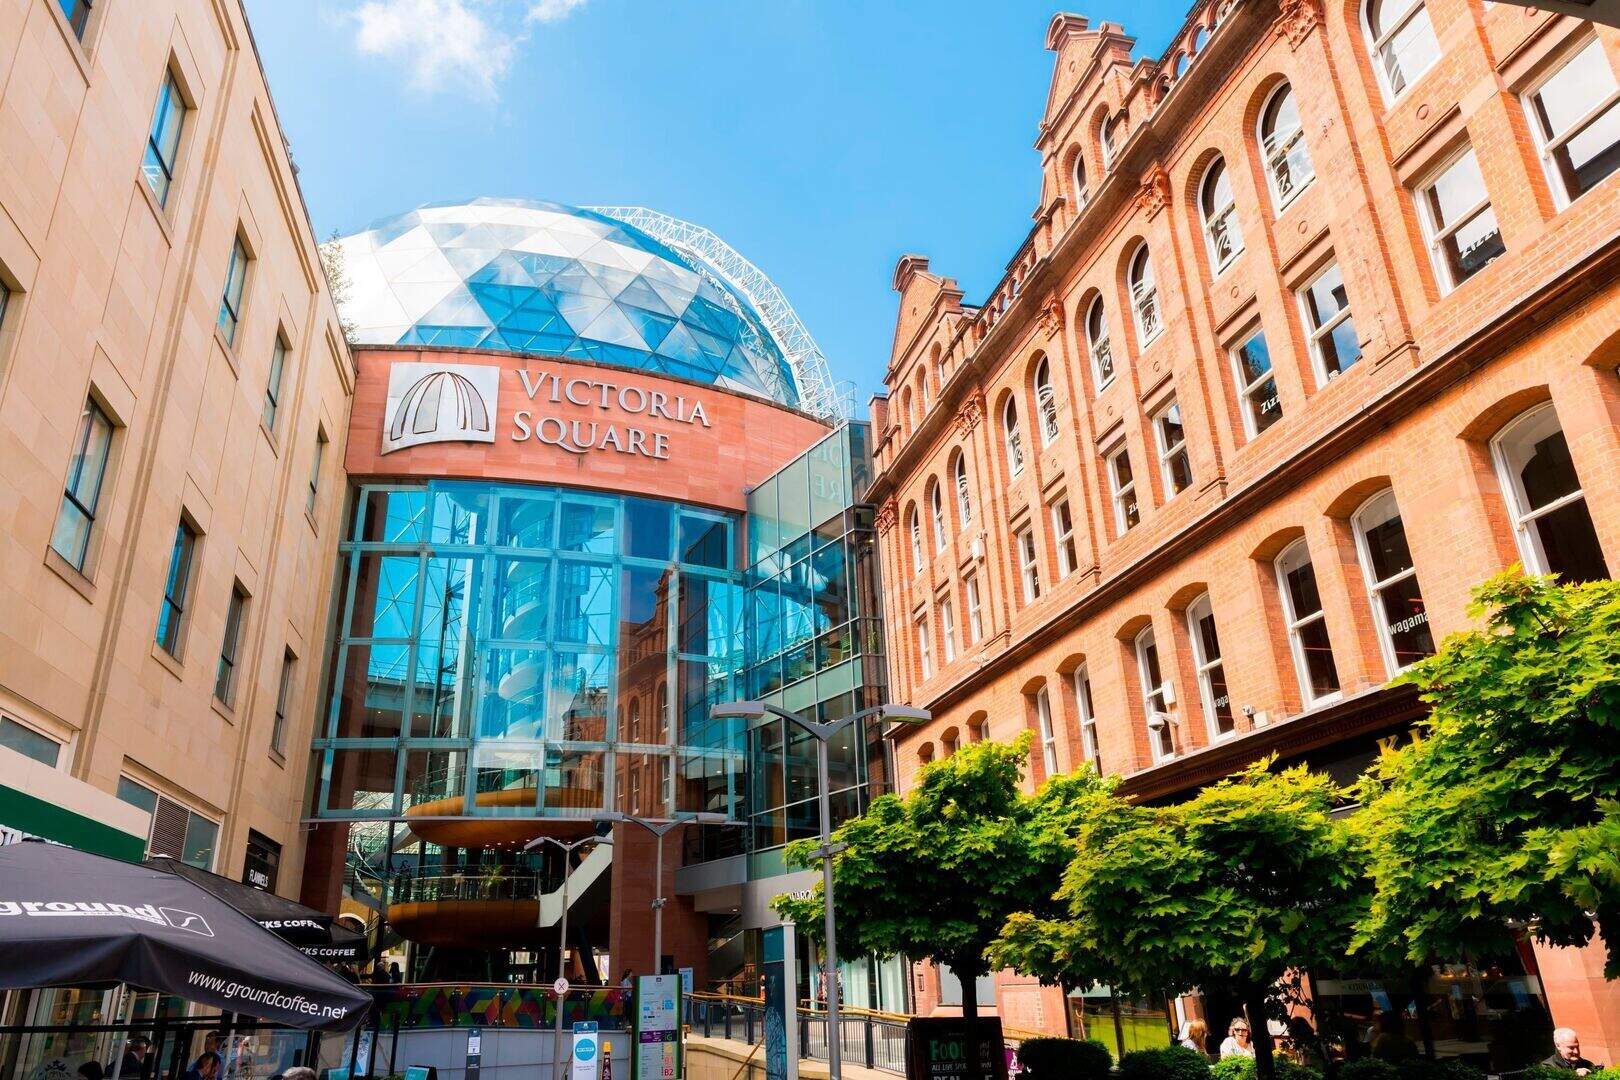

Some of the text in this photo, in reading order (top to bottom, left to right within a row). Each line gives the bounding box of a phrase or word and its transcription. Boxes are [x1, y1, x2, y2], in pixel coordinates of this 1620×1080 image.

[515, 369, 711, 428] VICTORIA
[511, 410, 670, 460] SQUARE
[249, 869, 269, 888] FLANNELS
[319, 948, 356, 957] COFFEE
[188, 970, 348, 1020] www.groundcoffee.net
